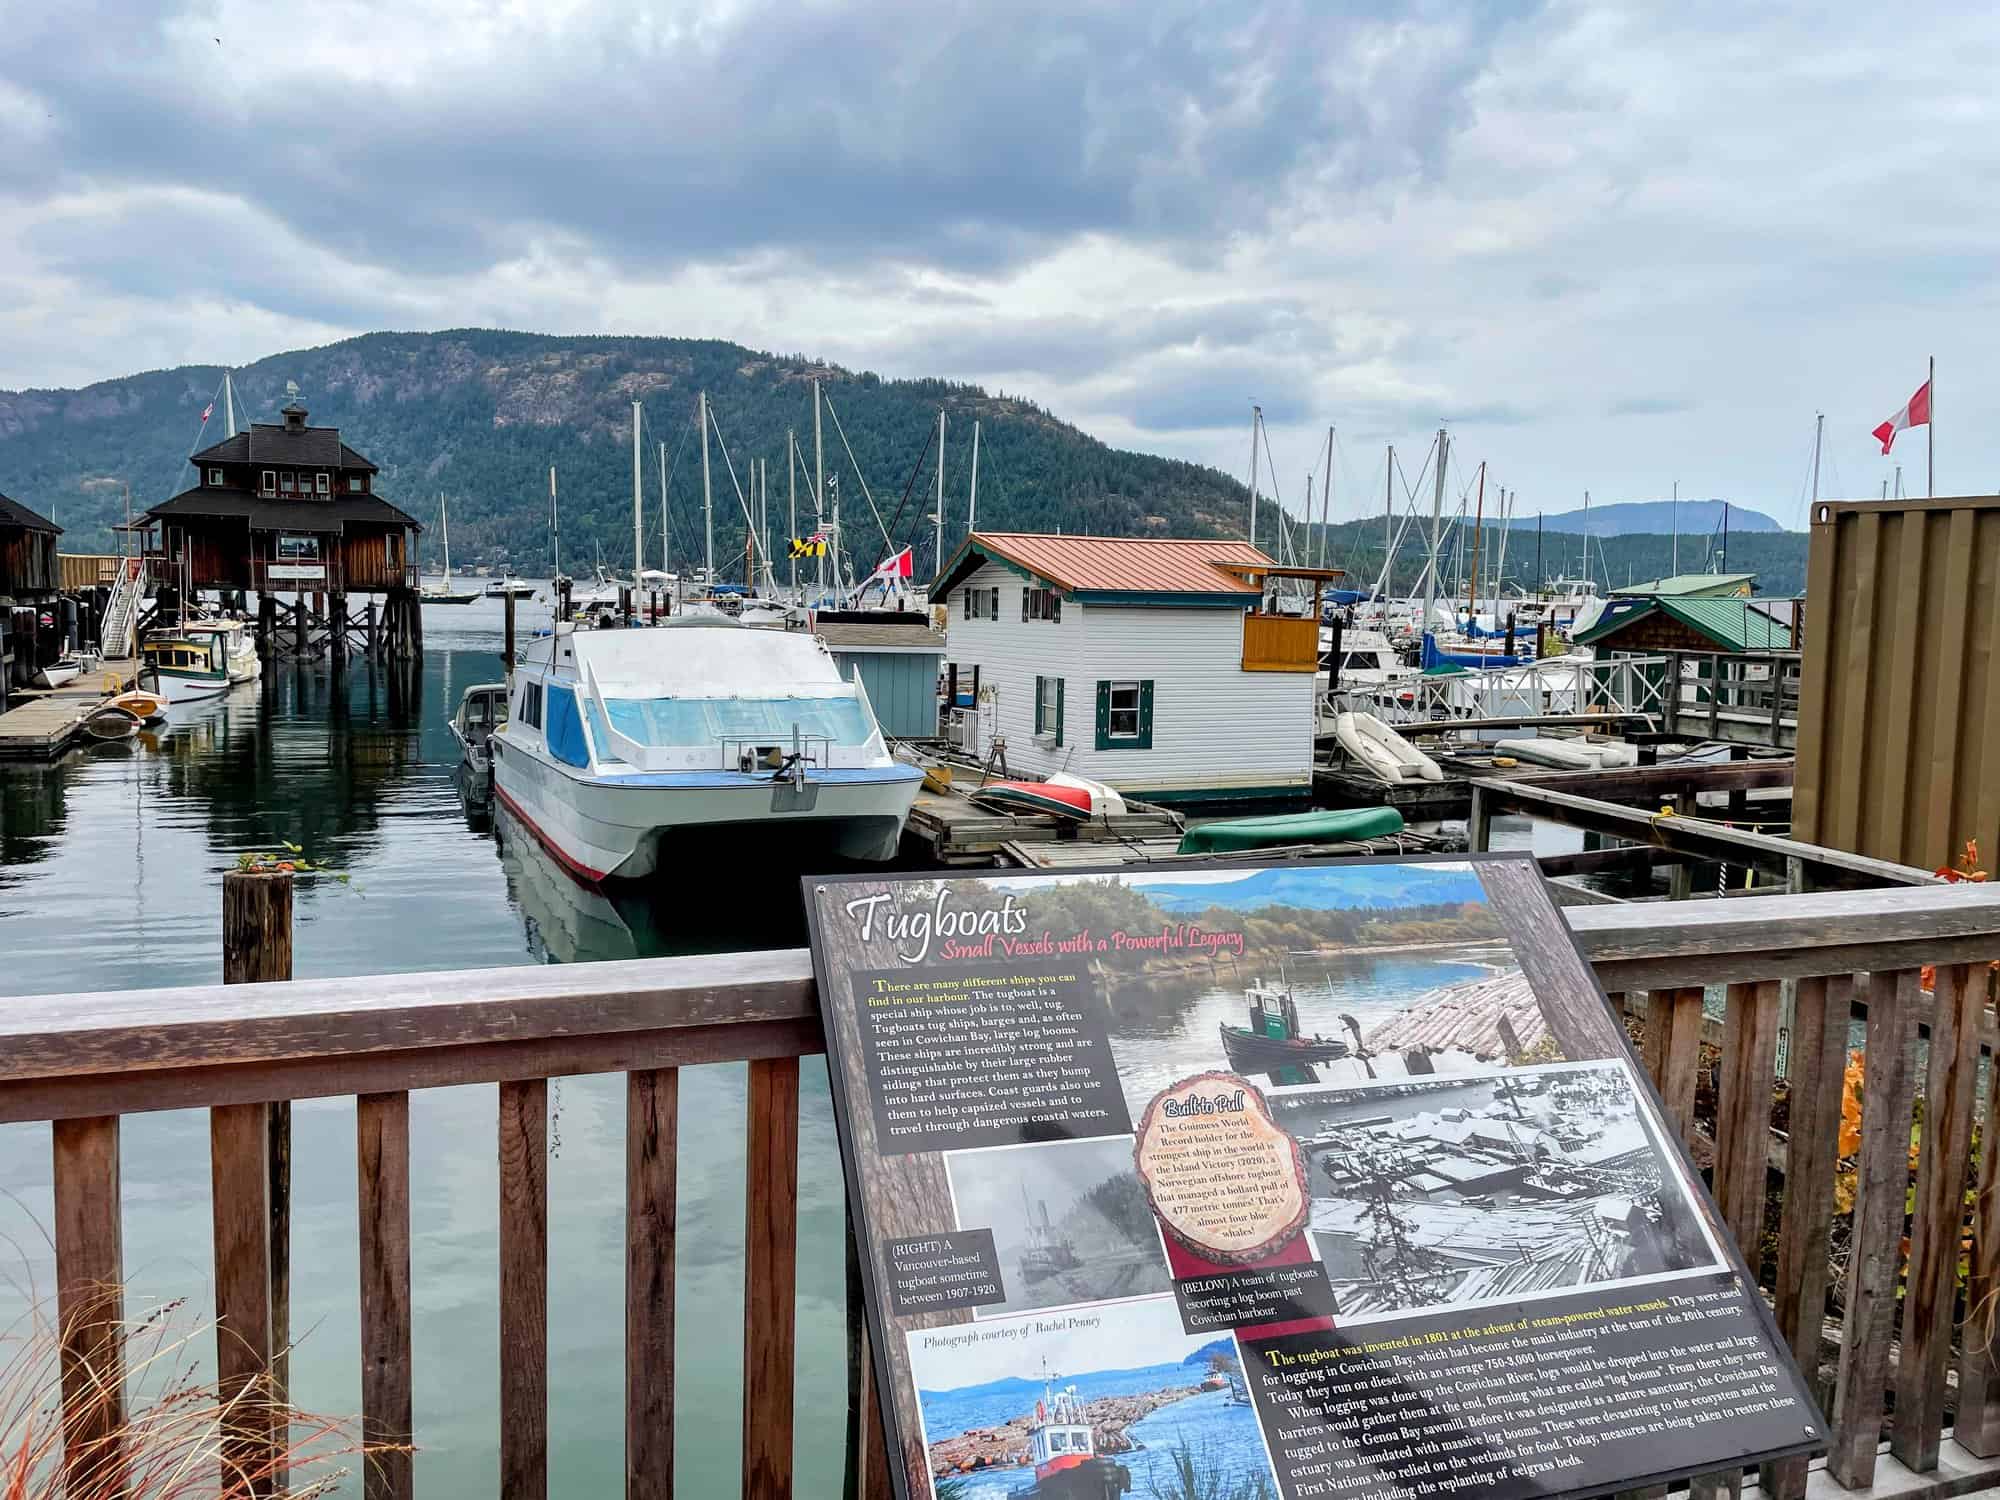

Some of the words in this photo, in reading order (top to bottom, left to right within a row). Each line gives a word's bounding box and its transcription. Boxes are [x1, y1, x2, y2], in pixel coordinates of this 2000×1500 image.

[846, 888, 1027, 963] Tugboats
[939, 934, 995, 960] Small
[997, 931, 1054, 956] Vessels
[1057, 929, 1093, 953] with
[1097, 938, 1108, 951] a
[1112, 923, 1184, 953] Powerful
[1188, 926, 1244, 956] Legacy
[872, 979, 911, 991] There
[932, 980, 961, 989] many
[961, 975, 1007, 986] different
[1009, 973, 1035, 985] ships
[1036, 974, 1056, 985] you
[867, 995, 890, 1004] find
[891, 994, 902, 1003] in
[925, 991, 970, 1001] harbour.
[971, 989, 994, 998] The
[995, 987, 1036, 999] tugboat
[1037, 985, 1048, 994] is
[870, 1007, 907, 1021] special
[909, 1006, 933, 1018] ship
[934, 1004, 968, 1014] whose
[968, 1002, 986, 1015] job
[988, 1002, 998, 1011] is
[1000, 1002, 1015, 1012] to,
[1016, 999, 1041, 1010] well,
[1043, 999, 1064, 1010] tug.
[872, 1021, 925, 1034] Tugboats
[926, 1021, 947, 1031] tug
[947, 1018, 978, 1029] ships,
[980, 1016, 1015, 1027] barges
[1017, 1013, 1040, 1024] and,
[1054, 1011, 1082, 1020] often
[875, 1038, 899, 1046] seen
[901, 1035, 913, 1044] in
[914, 1032, 967, 1043] Cowichan
[969, 1030, 992, 1042] Bay,
[993, 1029, 1022, 1040] large
[1022, 1027, 1041, 1039] log
[1041, 1026, 1078, 1035] booms.
[879, 1060, 962, 1075] distinguishable
[964, 1059, 979, 1071] by
[980, 1057, 1007, 1067] their
[1008, 1056, 1037, 1067] large
[1038, 1053, 1073, 1063] rubber
[884, 1094, 908, 1103] into
[910, 1091, 936, 1101] hard
[938, 1089, 986, 1099] surfaces.
[987, 1086, 1019, 1095] Coast
[1021, 1082, 1058, 1096] guards
[1058, 1081, 1081, 1090] also
[1163, 1094, 1199, 1117] Built
[1200, 1096, 1214, 1114] to
[1214, 1090, 1245, 1113] Pull
[889, 1122, 922, 1133] travel
[924, 1118, 970, 1131] through
[969, 1116, 1029, 1128] dangerous
[1030, 1110, 1069, 1122] coastal
[1071, 1110, 1108, 1119] waters.
[891, 1240, 942, 1258] (RIGHT)
[941, 1239, 952, 1249] A
[894, 1251, 980, 1270] Vancouver-based
[896, 1274, 936, 1288] tugboat
[938, 1268, 988, 1281] sometime
[1180, 1278, 1230, 1295] (BELOW)
[1230, 1277, 1240, 1287] A
[1241, 1277, 1264, 1285] team
[1265, 1272, 1275, 1283] of
[1279, 1269, 1319, 1283] tugboats
[898, 1292, 942, 1302] between
[1185, 1295, 1231, 1308] escorting
[1238, 1292, 1255, 1304] log
[1254, 1290, 1282, 1300] boom
[1282, 1287, 1302, 1300] past
[1189, 1311, 1236, 1324] Cowichan
[1237, 1306, 1277, 1318] harbour.
[924, 1331, 978, 1348] Photograph
[981, 1330, 1017, 1341] courtesy
[1019, 1325, 1028, 1336] of
[1033, 1321, 1065, 1334] Rachel
[1069, 1319, 1099, 1331] Penney
[1264, 1351, 1296, 1366] The
[1296, 1346, 1339, 1364] tugboat
[1342, 1345, 1362, 1355] was
[1362, 1335, 1410, 1351] invented
[1409, 1334, 1421, 1344] in
[1422, 1329, 1448, 1343] 1801
[1449, 1329, 1463, 1339] at
[1462, 1326, 1481, 1337] the
[1481, 1321, 1515, 1334] advent
[1516, 1318, 1528, 1329] of
[1531, 1307, 1605, 1327] steam-powered
[1605, 1305, 1634, 1316] water
[1670, 1295, 1697, 1307] They
[1695, 1293, 1720, 1302] were
[1266, 1390, 1305, 1403] Today
[1305, 1386, 1331, 1399] they
[1331, 1384, 1352, 1393] run
[1353, 1381, 1368, 1390] on
[1368, 1373, 1401, 1387] diesel
[1403, 1369, 1428, 1382] with
[1429, 1370, 1443, 1378] an
[1444, 1363, 1484, 1376] average
[1484, 1352, 1535, 1369] 750-3,000
[1287, 1406, 1323, 1419] When
[1323, 1399, 1368, 1416] logging
[1368, 1397, 1389, 1406] was
[1389, 1392, 1418, 1403] done
[1419, 1390, 1435, 1401] up
[1435, 1384, 1454, 1396] the
[1454, 1377, 1506, 1392] Cowichan
[1506, 1373, 1538, 1384] River,
[1560, 1361, 1592, 1375] would
[1592, 1360, 1608, 1370] be
[1606, 1352, 1648, 1369] dropped
[1647, 1351, 1670, 1361] into
[1669, 1347, 1688, 1358] the
[1688, 1344, 1716, 1355] water
[1716, 1339, 1735, 1350] and
[1733, 1338, 1760, 1348] large
[1294, 1482, 1325, 1496] First
[1325, 1476, 1371, 1490] Nations
[1372, 1469, 1397, 1482] who
[1398, 1461, 1431, 1477] relied
[1432, 1462, 1447, 1471] on
[1448, 1456, 1468, 1468] the
[1468, 1447, 1517, 1464] wetlands
[1516, 1445, 1535, 1455] for
[1534, 1438, 1563, 1452] food.
[1564, 1433, 1600, 1446] Today,
[1599, 1425, 1647, 1440] measures
[1647, 1422, 1665, 1431] are
[1664, 1416, 1695, 1428] being
[1693, 1411, 1722, 1422] taken
[1722, 1409, 1735, 1417] to
[1734, 1403, 1770, 1415] restore
[1769, 1398, 1795, 1408] these
